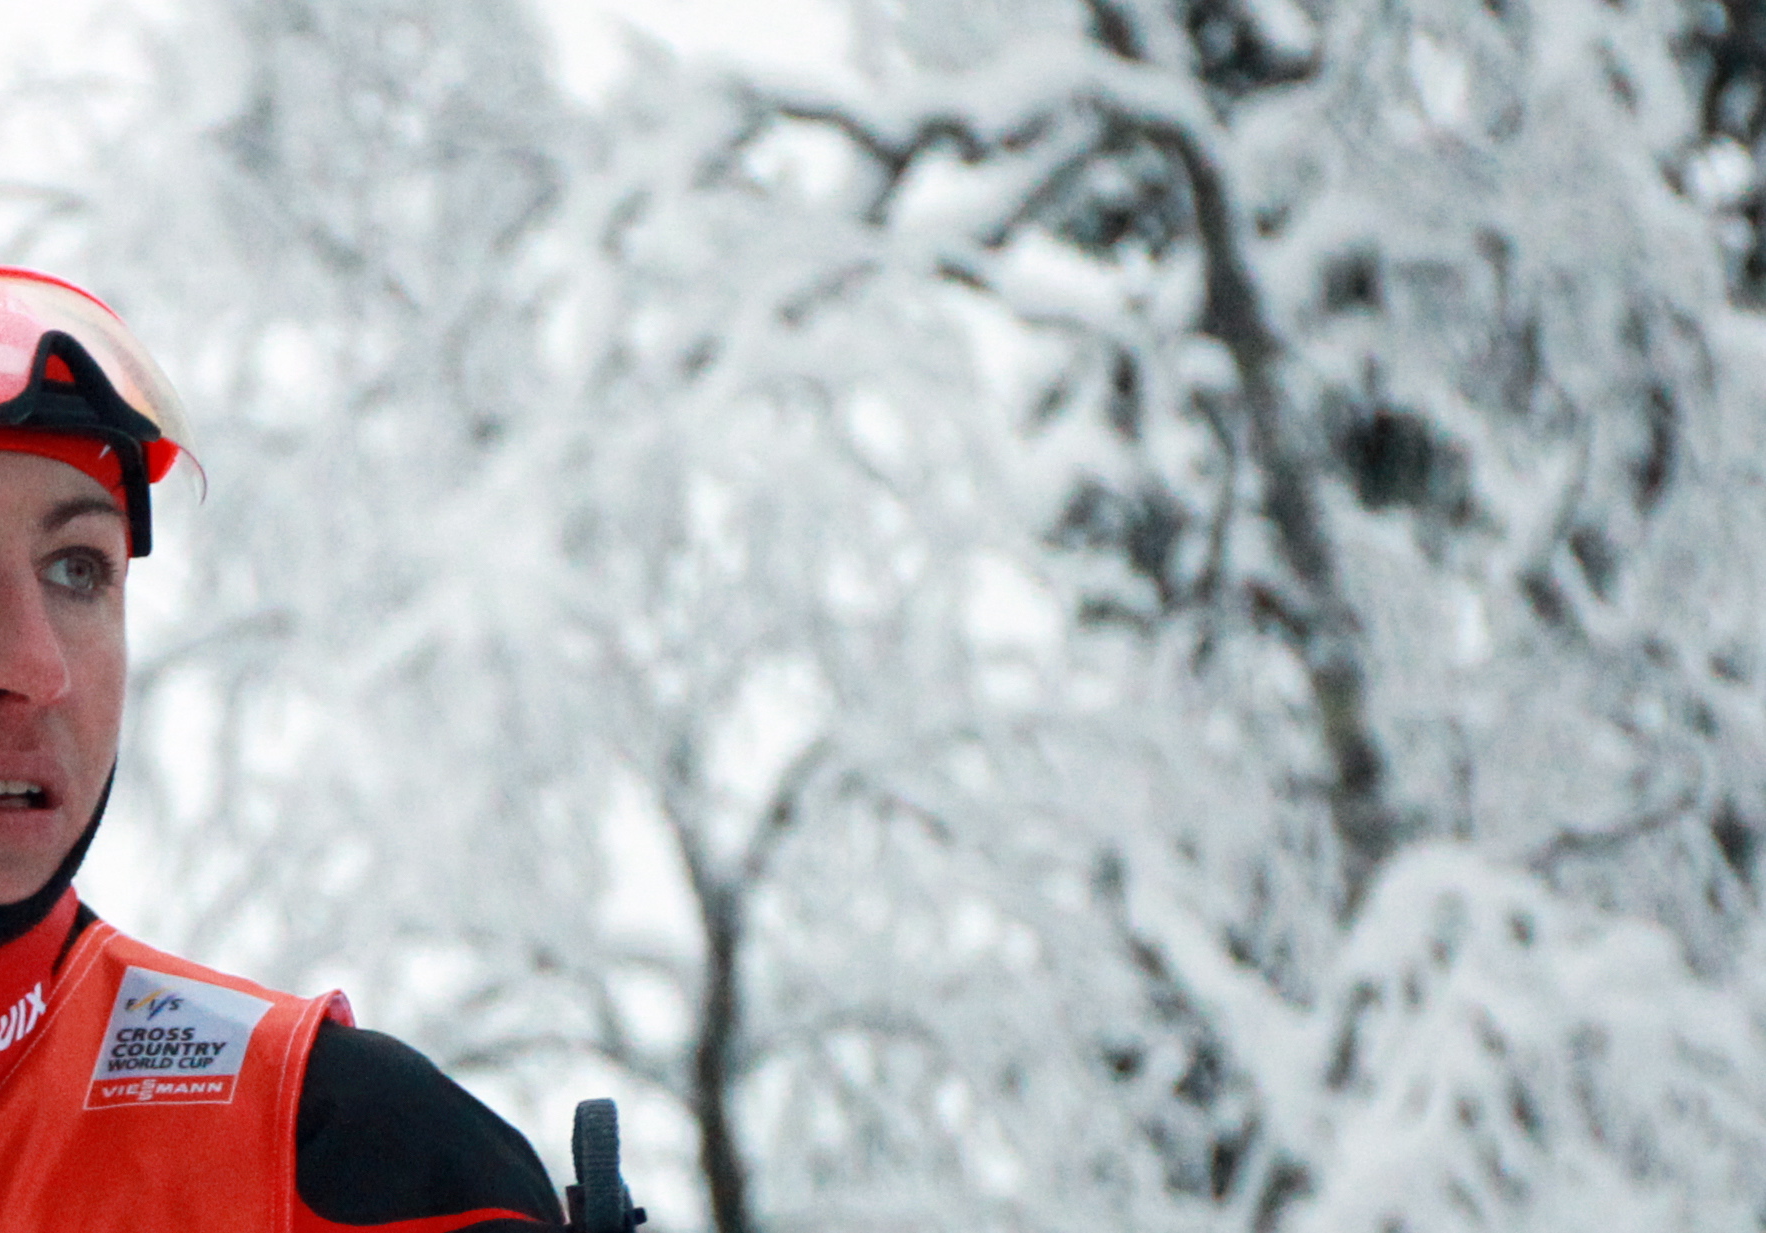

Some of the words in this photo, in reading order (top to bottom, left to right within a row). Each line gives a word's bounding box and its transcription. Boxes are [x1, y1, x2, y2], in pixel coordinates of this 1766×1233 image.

[116, 1027, 196, 1042] CROSS
[111, 1042, 227, 1057] COUNTRY
[107, 1057, 173, 1071] WORLD
[178, 1057, 214, 1069] CUP
[101, 1078, 223, 1101] VIESSMANN
